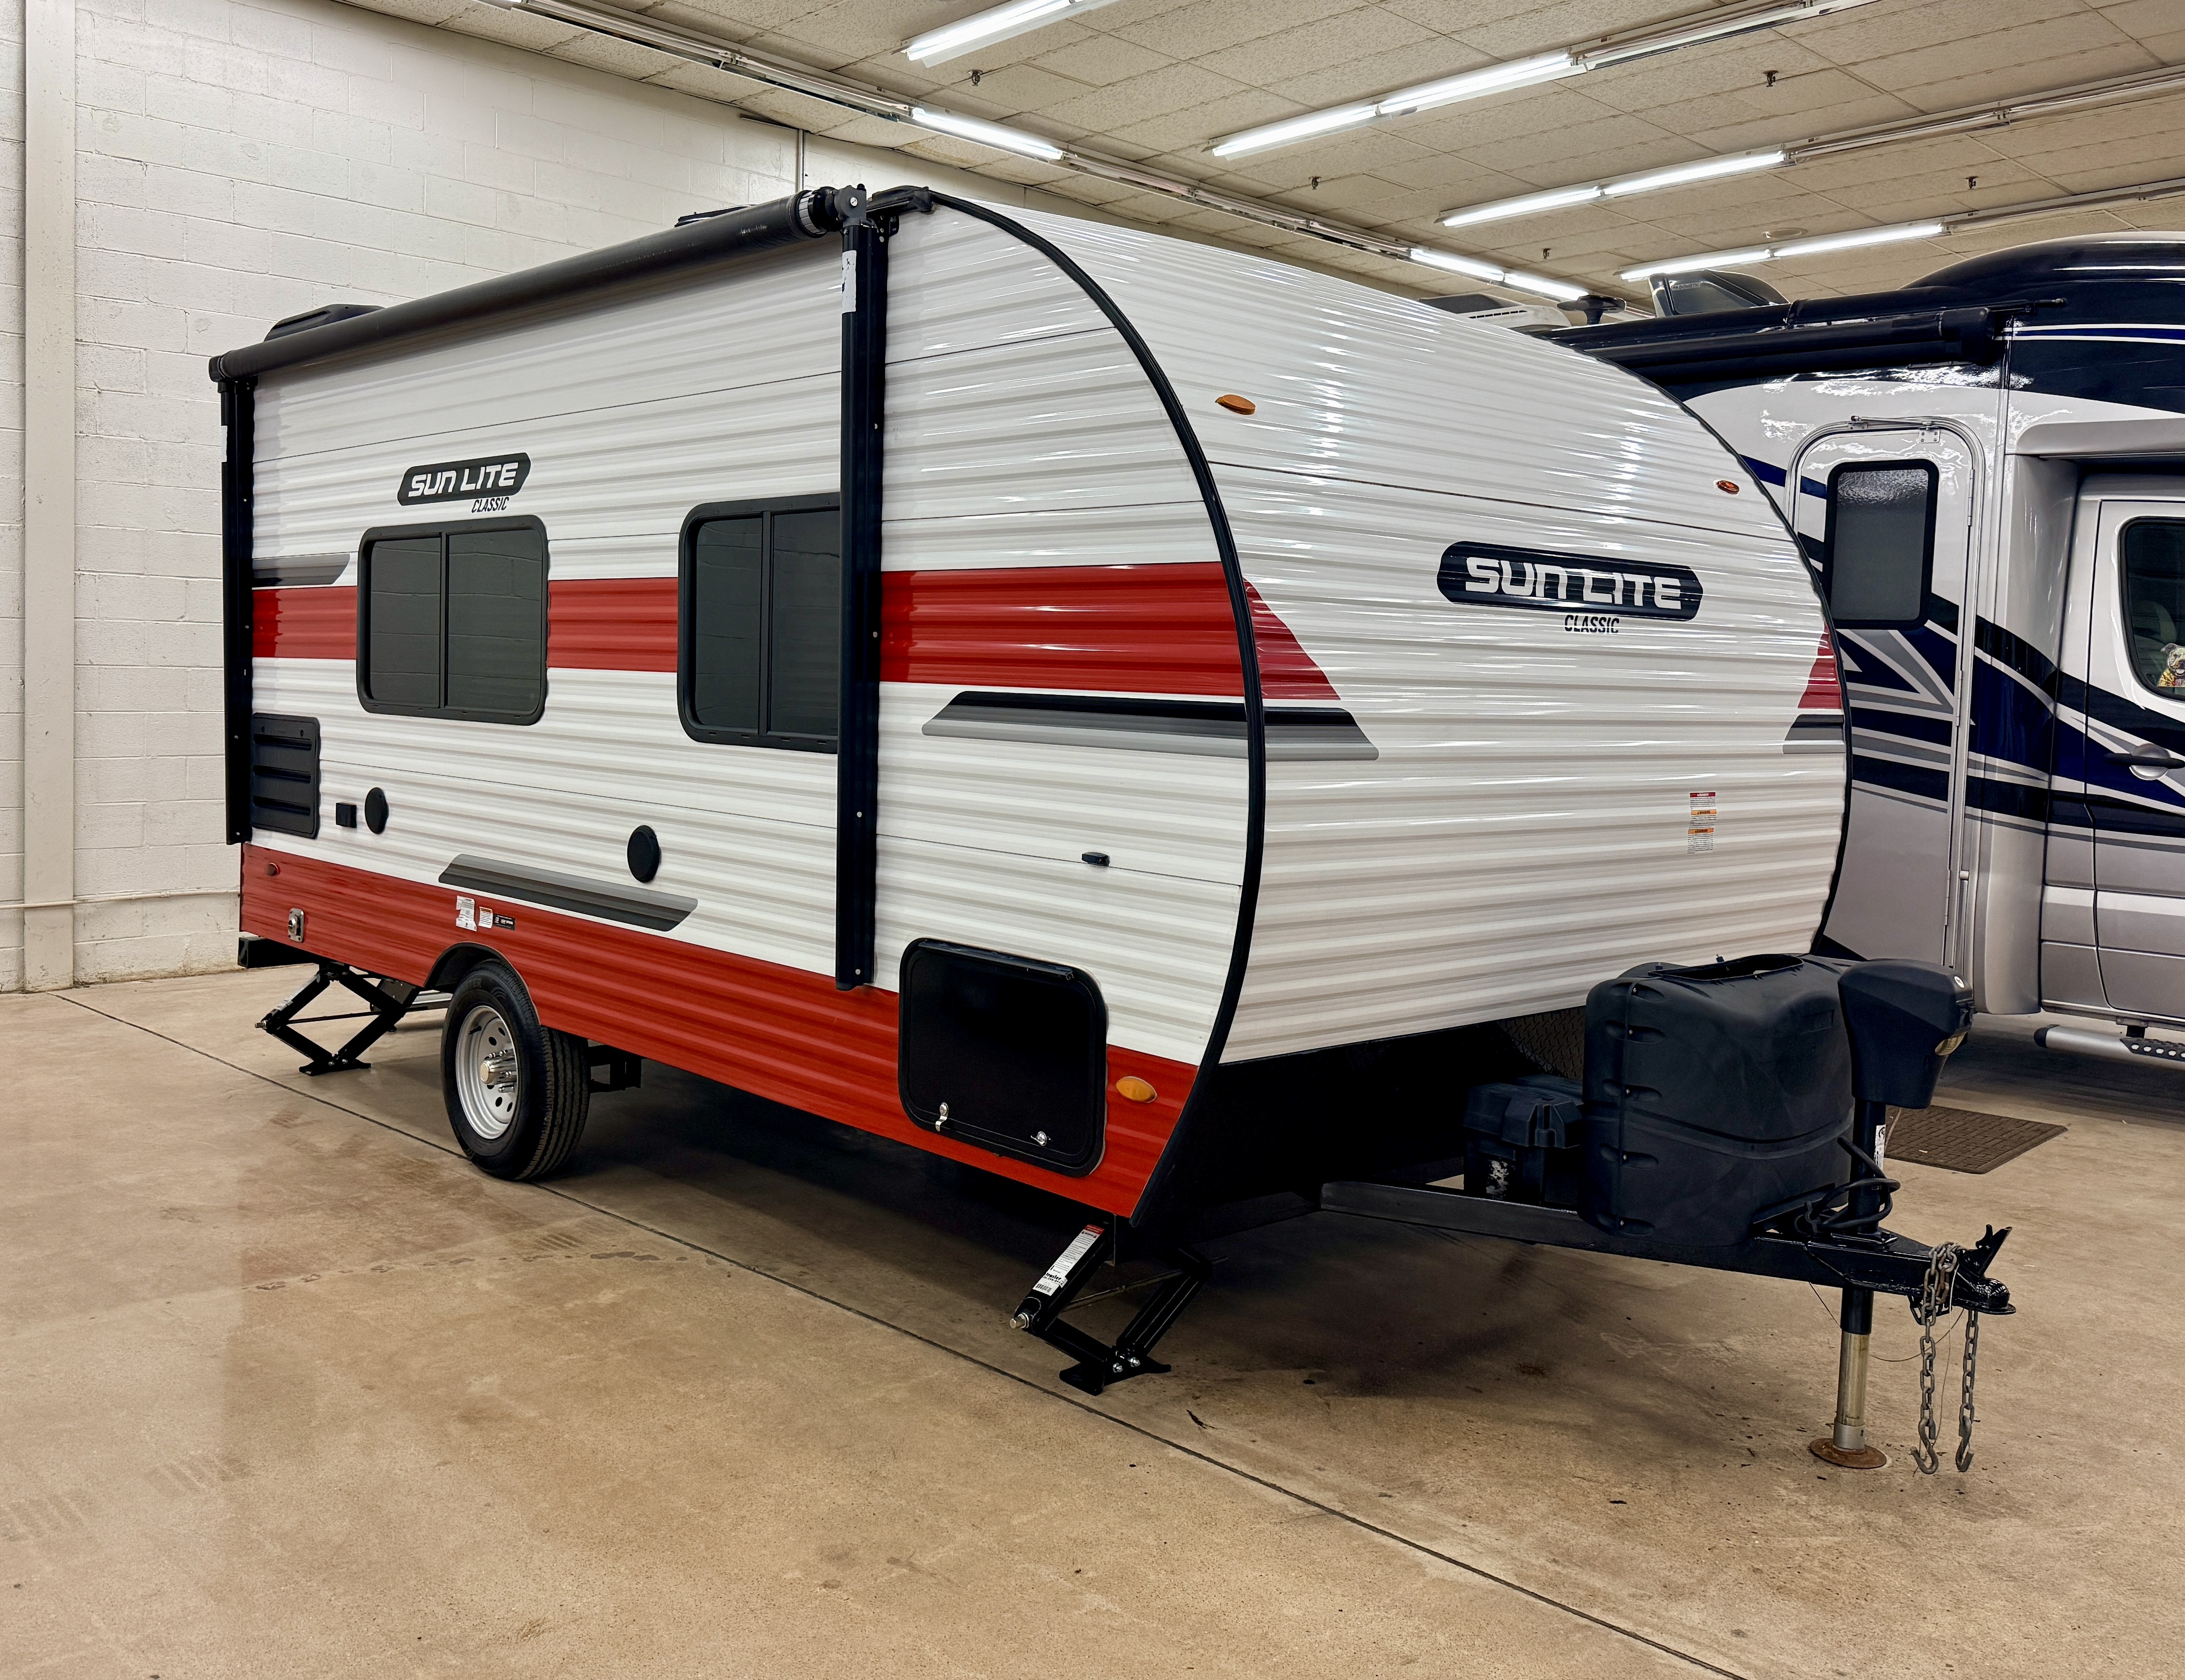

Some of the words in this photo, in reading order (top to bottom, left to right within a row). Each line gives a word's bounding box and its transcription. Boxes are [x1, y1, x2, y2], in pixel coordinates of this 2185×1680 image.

[408, 471, 457, 497] SUN
[460, 462, 518, 492] LITE
[471, 497, 509, 513] CLASSIC
[1465, 557, 1567, 600] SUN
[1583, 569, 1681, 609] LITE
[1564, 615, 1620, 634] CLASSIC
